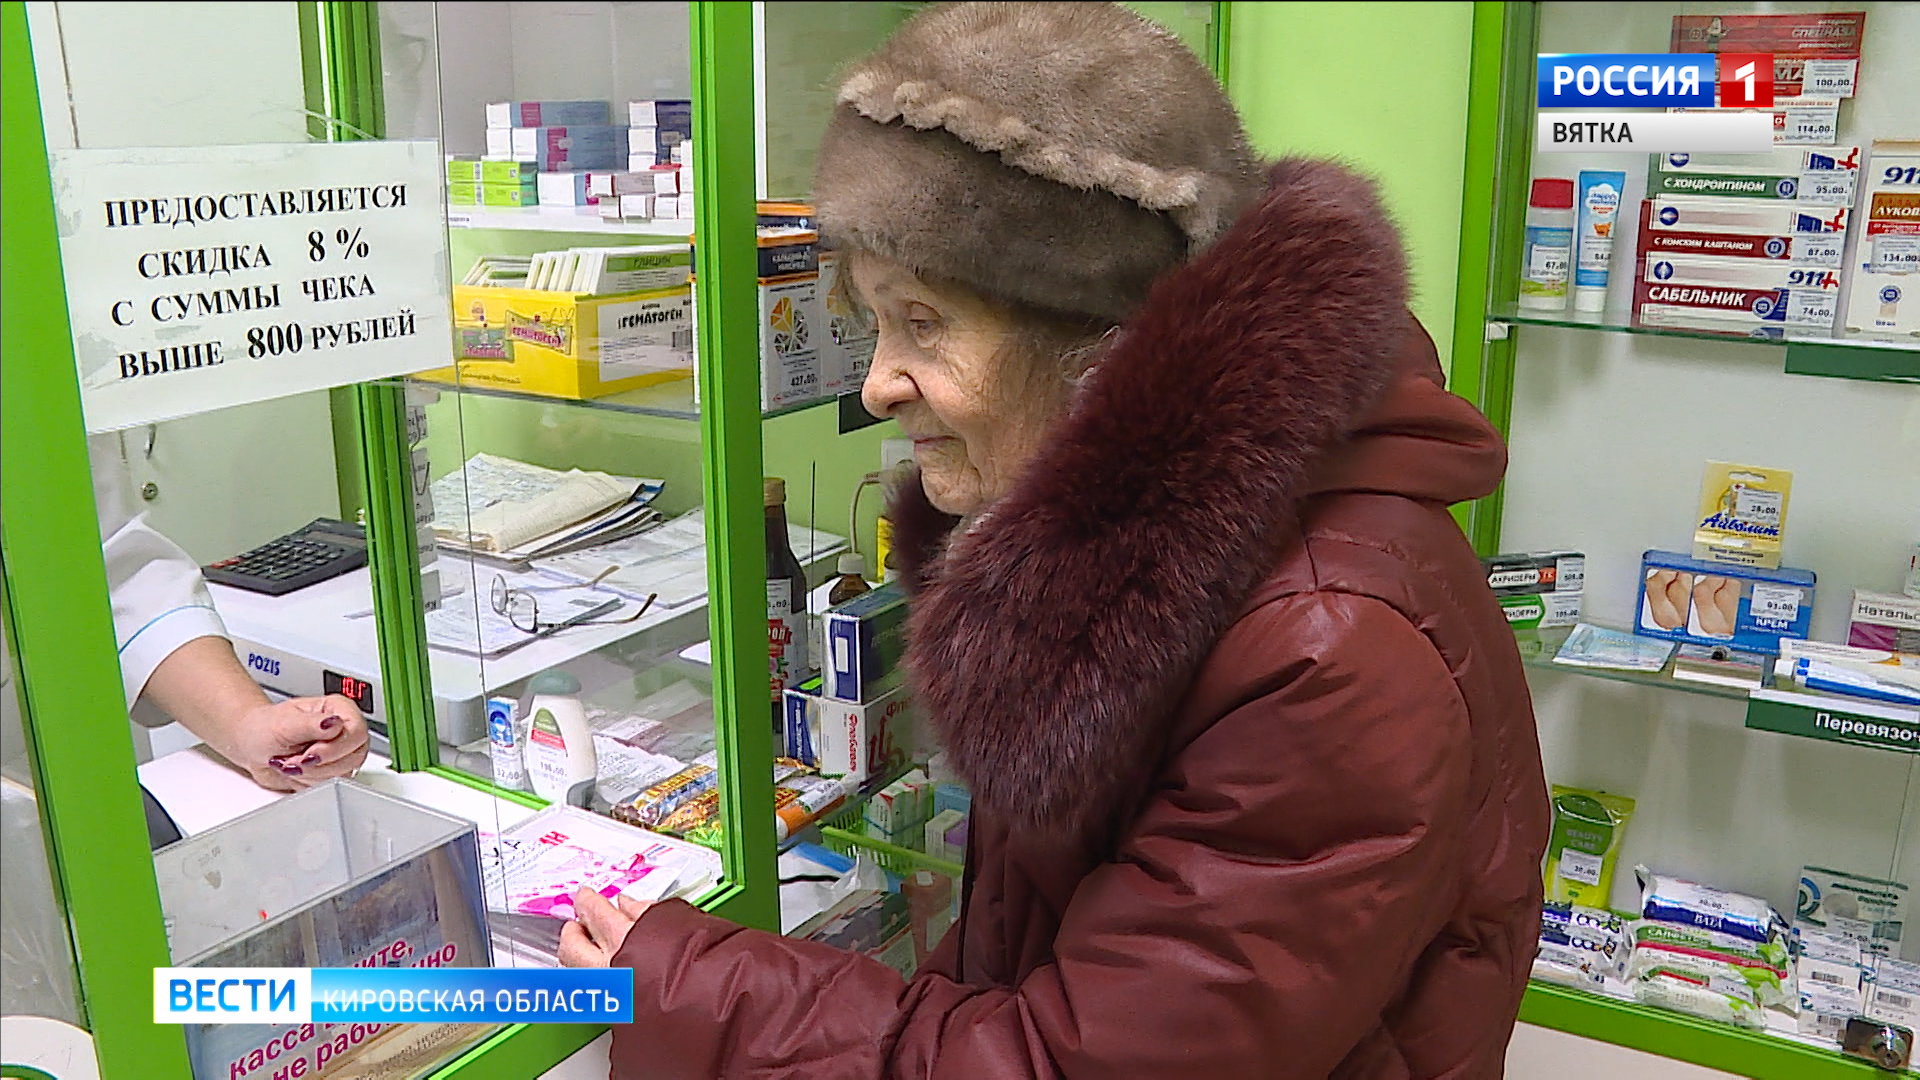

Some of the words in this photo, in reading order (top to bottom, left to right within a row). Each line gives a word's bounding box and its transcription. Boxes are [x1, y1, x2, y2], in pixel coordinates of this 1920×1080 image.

[1673, 179, 1767, 192] ХОНДРОИТИНОМ
[104, 183, 408, 228] ПРЕДОСТАВЛЯЕТСЯ
[138, 243, 272, 280] СКИДКА
[308, 229, 326, 263] 8
[336, 227, 370, 260] %
[1704, 241, 1754, 251] КАШТАНОМ
[111, 299, 133, 327] С
[151, 284, 281, 323] СУММЫ
[302, 274, 376, 304] ЧЕКА
[1649, 287, 1748, 307] САБЕЛЬНИК
[118, 341, 225, 380] ВЫШЕ
[247, 322, 302, 360] 800
[312, 308, 417, 351] РУБЛЕЙ
[248, 653, 281, 676] POZIS
[272, 1057, 308, 1080] не
